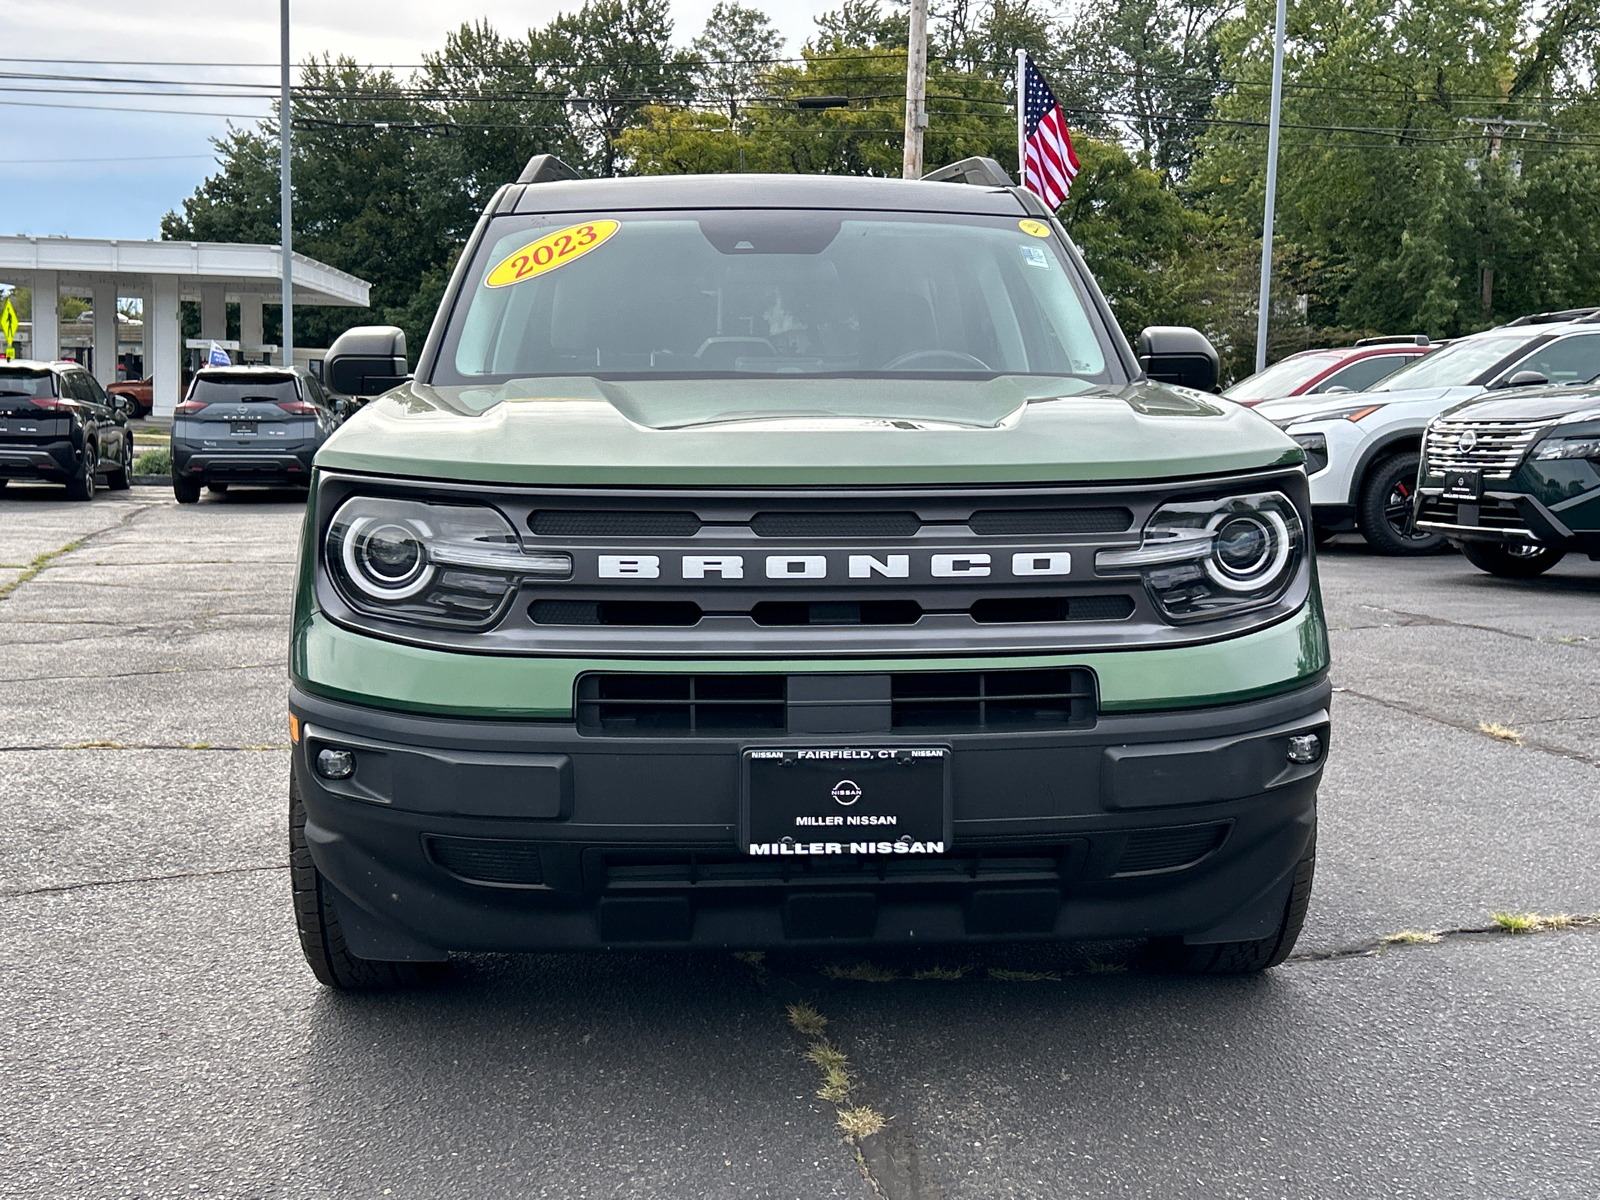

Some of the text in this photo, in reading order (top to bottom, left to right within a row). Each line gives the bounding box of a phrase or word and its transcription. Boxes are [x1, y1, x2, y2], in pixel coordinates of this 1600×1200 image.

[511, 225, 597, 279] 2023
[598, 552, 1072, 580] BRONCO
[797, 750, 898, 759] FAIRFIELD, CT
[911, 750, 944, 758] NISSAN
[795, 815, 897, 826] MILLER NISSAN
[749, 842, 944, 855] MILLER NISSAN
